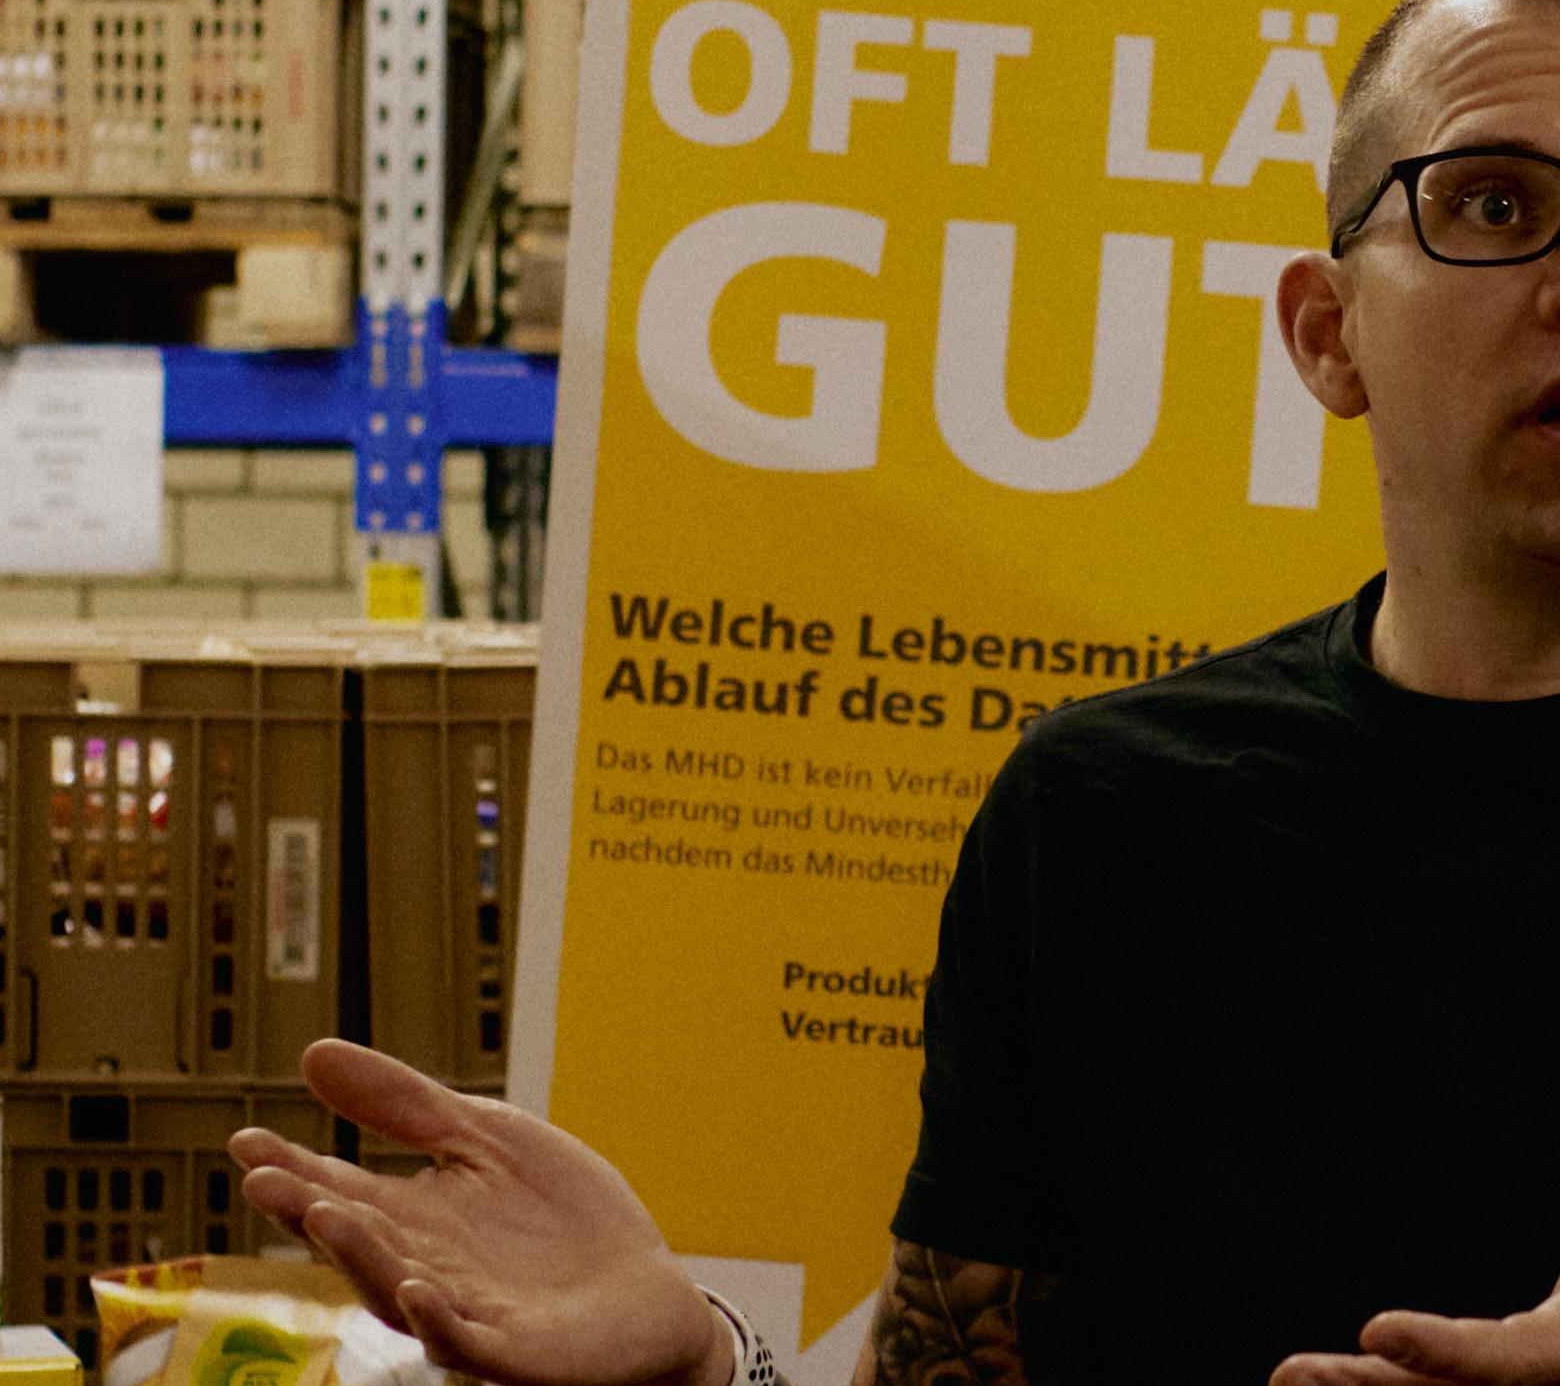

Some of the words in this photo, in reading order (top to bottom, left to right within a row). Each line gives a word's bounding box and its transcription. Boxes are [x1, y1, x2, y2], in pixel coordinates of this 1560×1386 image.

[634, 199, 1333, 511] GUT
[610, 592, 834, 654] Welche
[604, 658, 820, 717] Ablauf
[840, 676, 945, 729] des
[970, 688, 1074, 732] Da
[596, 742, 652, 774] Das
[666, 748, 745, 781] MHD
[758, 756, 792, 784] ist
[805, 757, 872, 790] kein
[592, 788, 740, 832] Lagerung
[753, 798, 811, 831] und
[590, 834, 732, 870] nachdem
[743, 844, 794, 875] das
[781, 1011, 925, 1049] Vertrau
